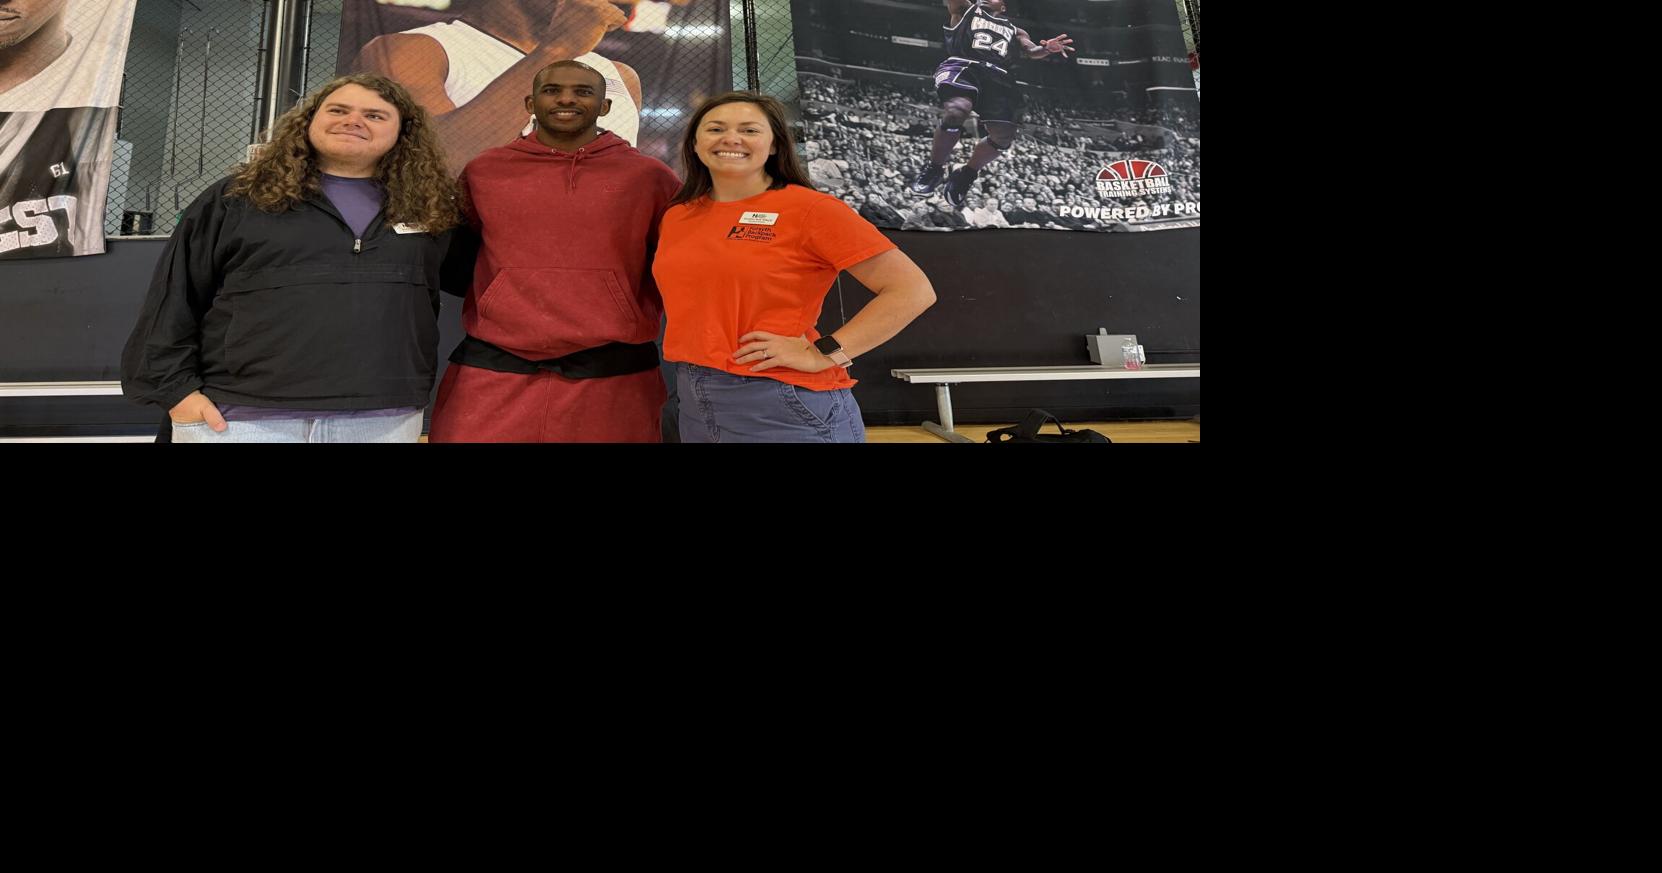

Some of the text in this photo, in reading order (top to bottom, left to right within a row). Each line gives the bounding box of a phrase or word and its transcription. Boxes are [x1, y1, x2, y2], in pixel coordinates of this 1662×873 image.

[971, 31, 1008, 57] 24
[1095, 176, 1171, 191] BASKETBALL
[1098, 187, 1172, 198] TRAINING SYSTEMS
[1059, 205, 1150, 220] POWERED
[1151, 203, 1171, 217] BY
